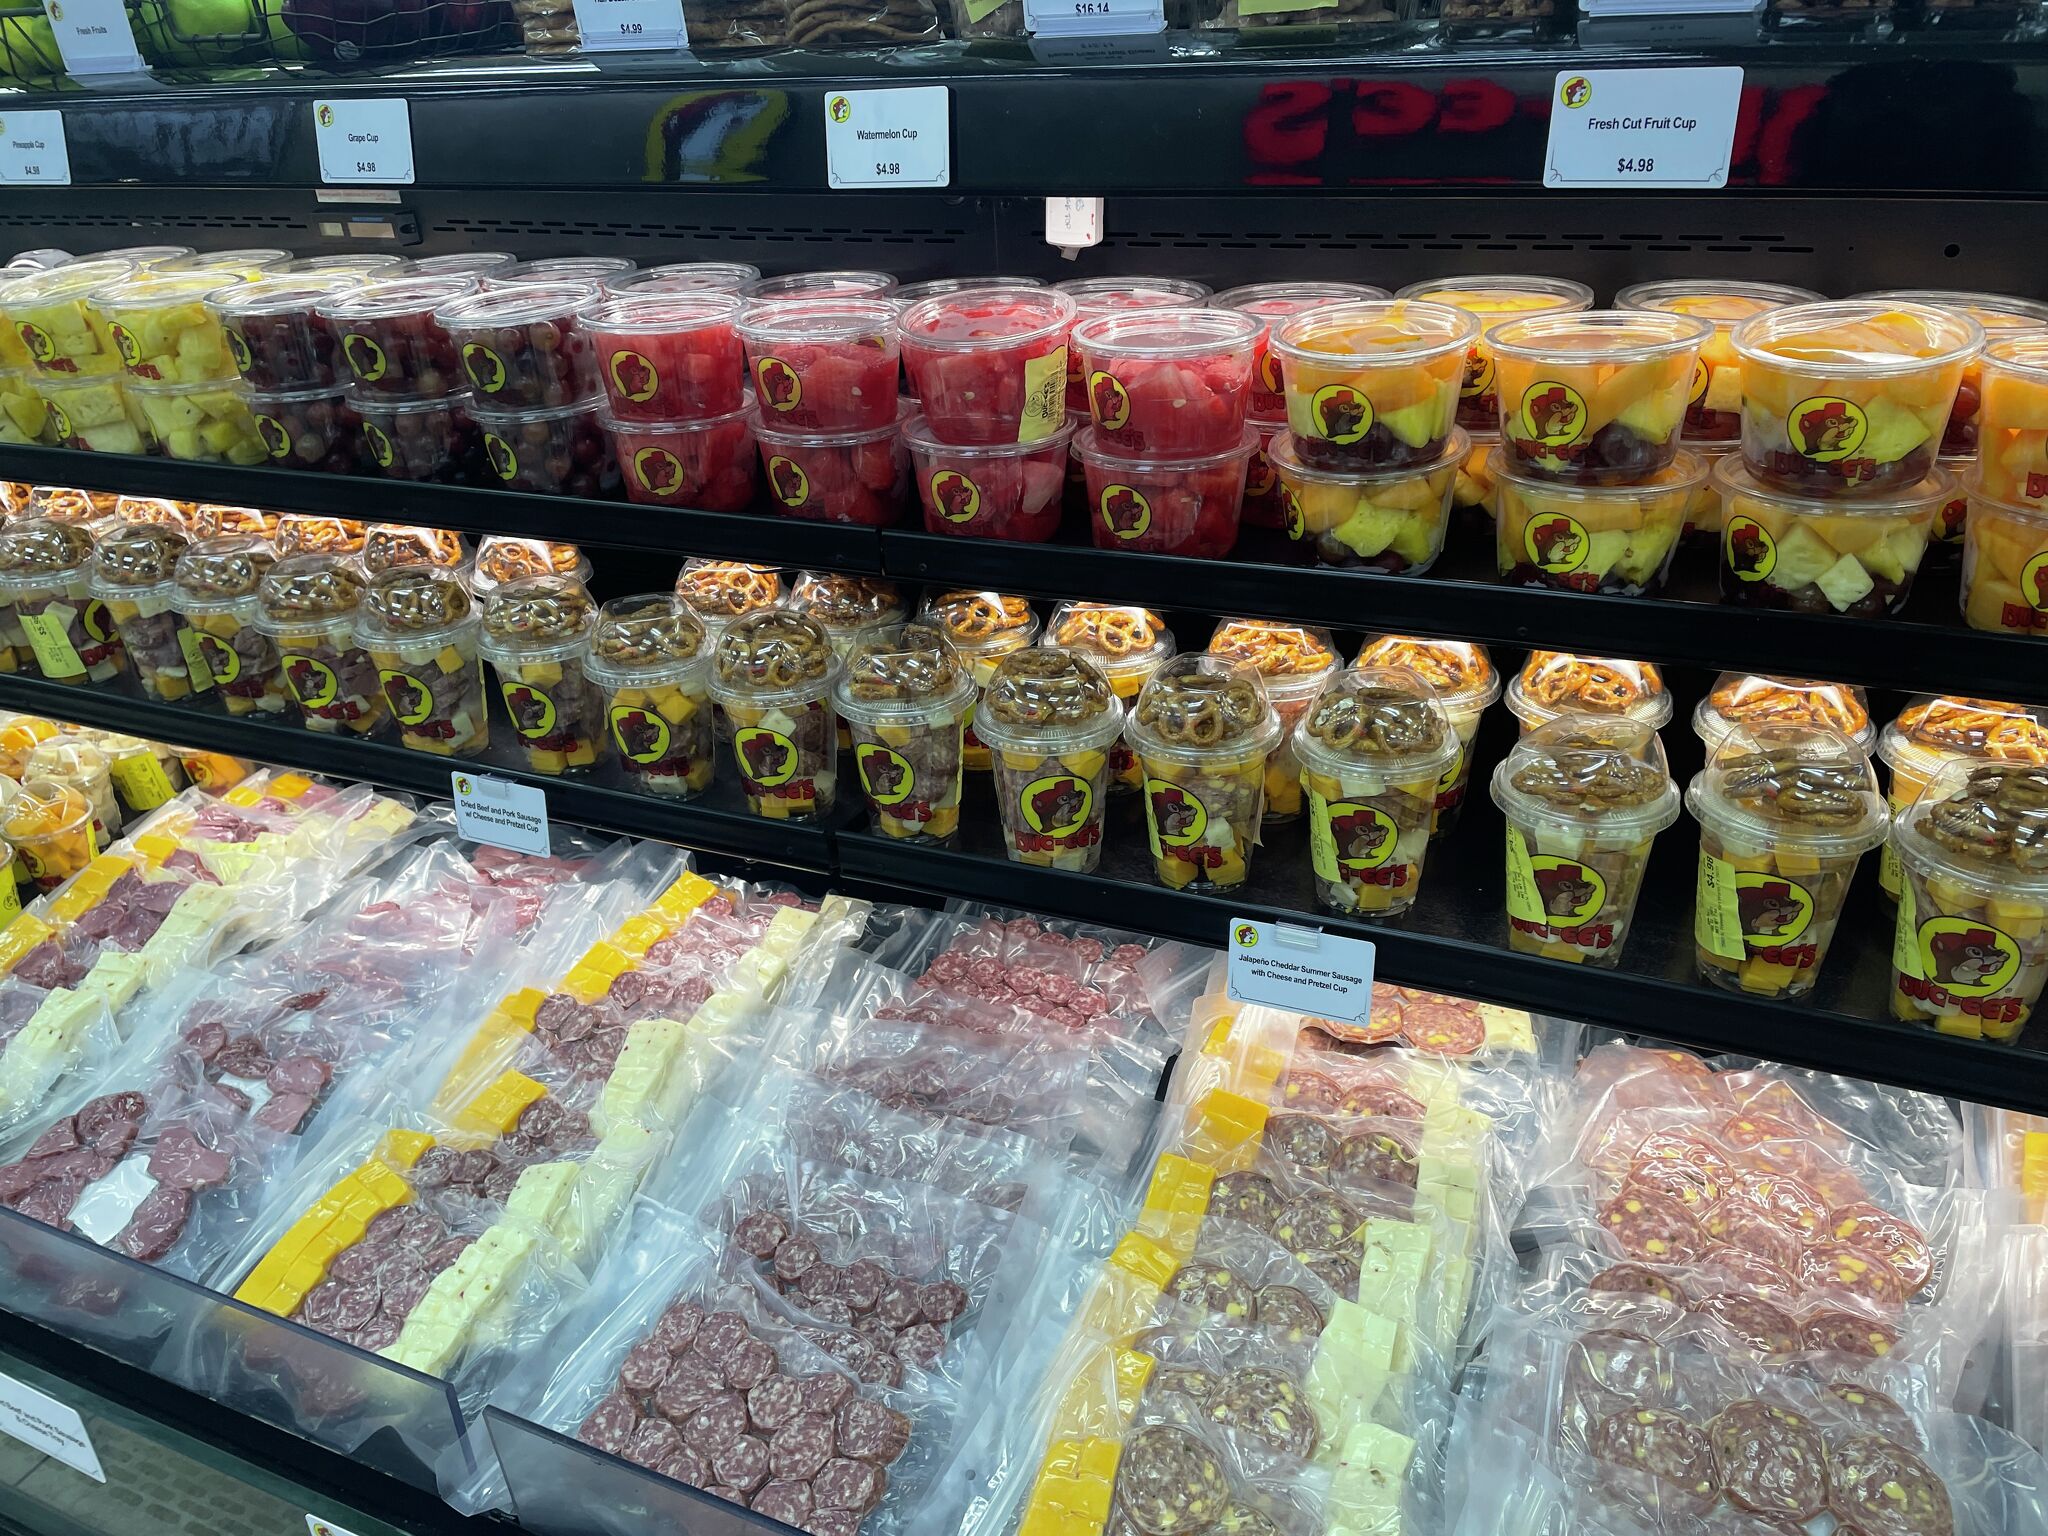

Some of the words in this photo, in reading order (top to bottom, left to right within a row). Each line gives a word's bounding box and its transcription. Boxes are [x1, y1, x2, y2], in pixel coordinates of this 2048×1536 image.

[1075, 3, 1110, 16] $16.14
[75, 26, 92, 36] Fresh
[92, 25, 108, 35] Fruits
[1588, 117, 1620, 130] Fresh
[1622, 117, 1643, 130] Cut
[1644, 116, 1671, 130] Fruit
[1673, 116, 1697, 132] Cup
[347, 133, 366, 144] Grape
[366, 133, 379, 144] Cup
[856, 129, 901, 140] Watermelon
[902, 128, 918, 141] Cup
[356, 161, 377, 174] $4.98
[875, 162, 900, 176] $4.98
[1617, 157, 1655, 174] $4.98
[460, 799, 475, 809] Dried
[476, 803, 489, 811] Beef
[502, 808, 515, 817] Pork
[516, 811, 541, 824] Sausage
[472, 811, 494, 821] Cheese
[506, 819, 526, 828] Pretzel
[526, 823, 539, 832] Cup
[1706, 855, 1716, 889] $4.98
[1238, 953, 1270, 967] Jalapeño
[1270, 959, 1300, 972] Cheddar
[1301, 965, 1331, 978] Summer
[1331, 971, 1363, 985] Sausage
[1251, 968, 1266, 978] with
[1266, 970, 1293, 983] Cheese
[1293, 976, 1307, 986] and
[1307, 978, 1332, 991] Pretzel
[1333, 983, 1348, 994] Cup
